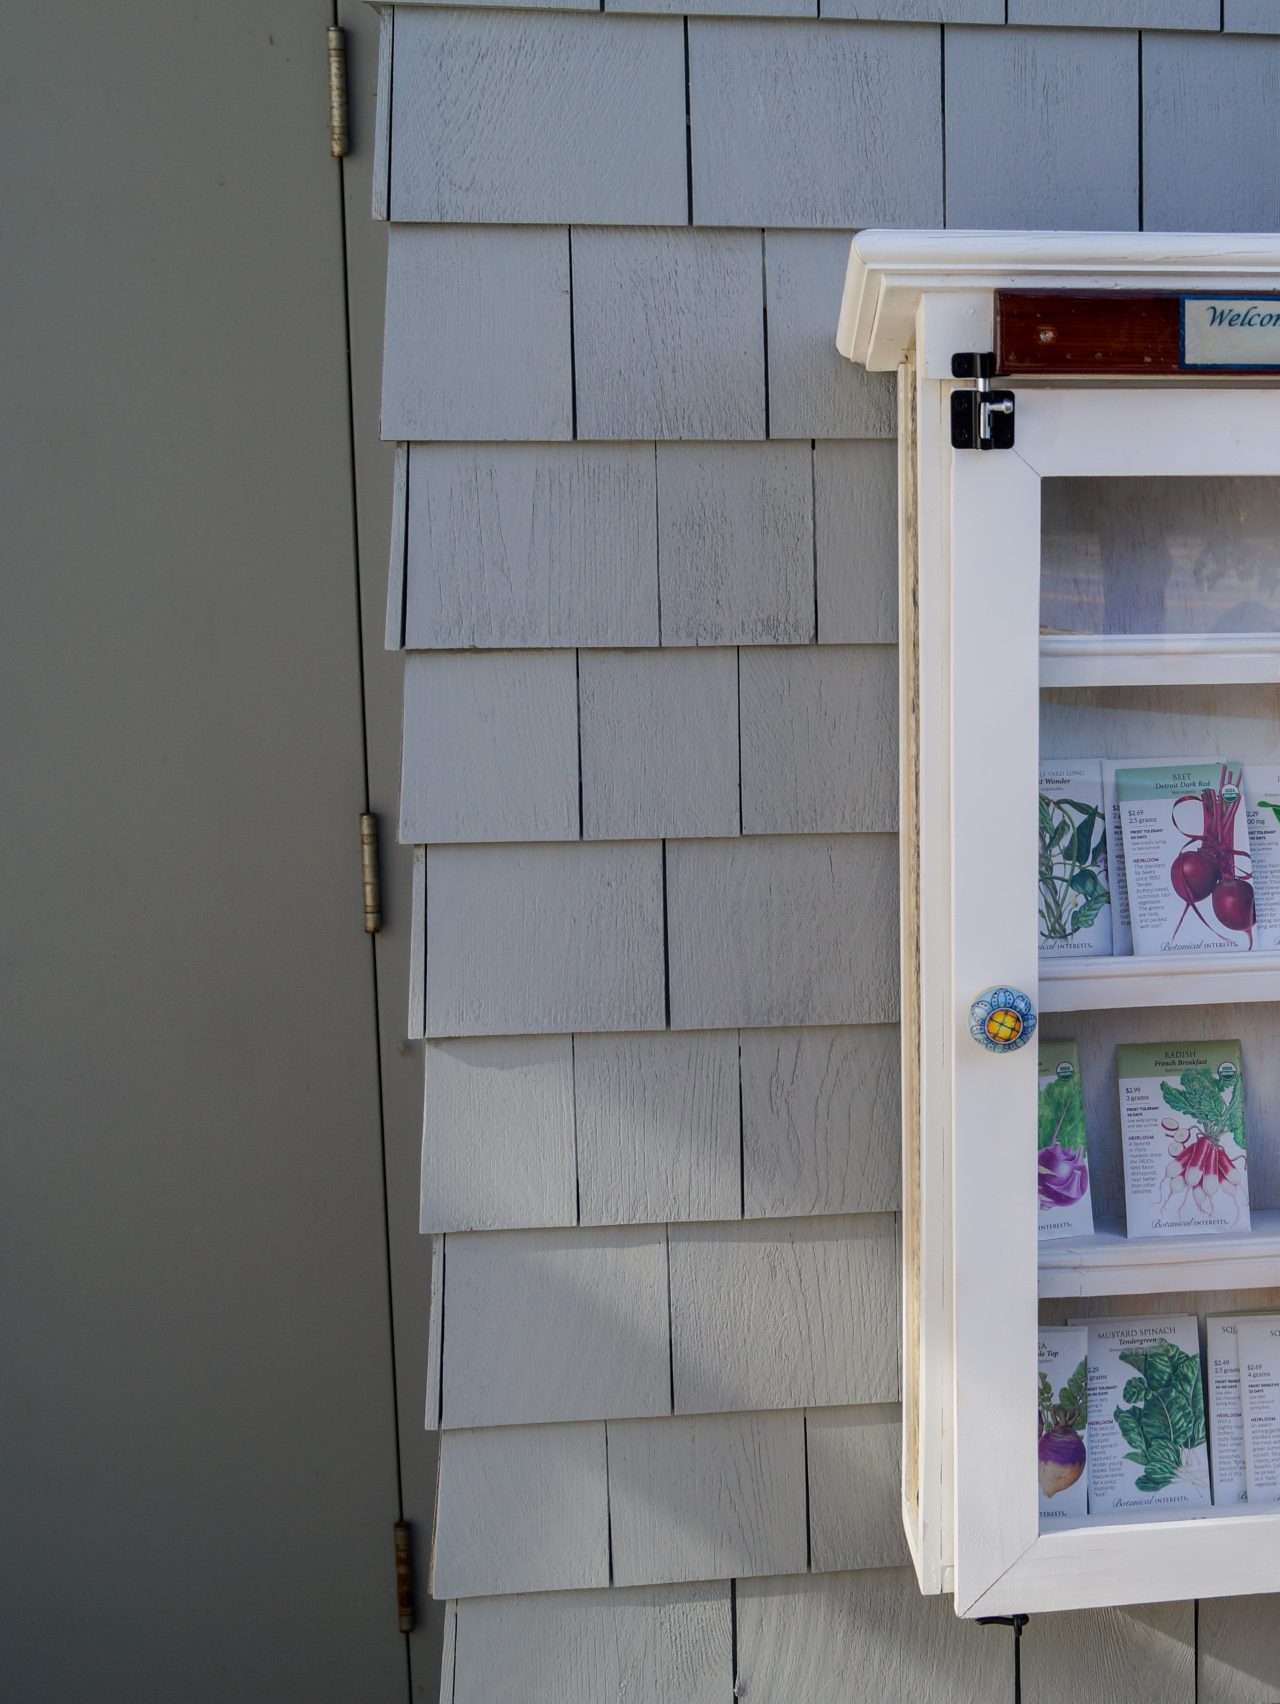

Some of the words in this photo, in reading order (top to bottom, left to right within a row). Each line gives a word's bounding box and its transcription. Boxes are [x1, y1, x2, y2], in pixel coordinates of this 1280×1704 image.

[1160, 940, 1203, 951] Botanical
[1164, 1051, 1196, 1059] RADISH
[1152, 1218, 1194, 1229] Botanical
[1097, 1330, 1137, 1339] MUSTARD
[1139, 1327, 1176, 1336] SPINACH
[1119, 1338, 1157, 1346] Tendergreen
[1113, 1496, 1154, 1507] Botanical
